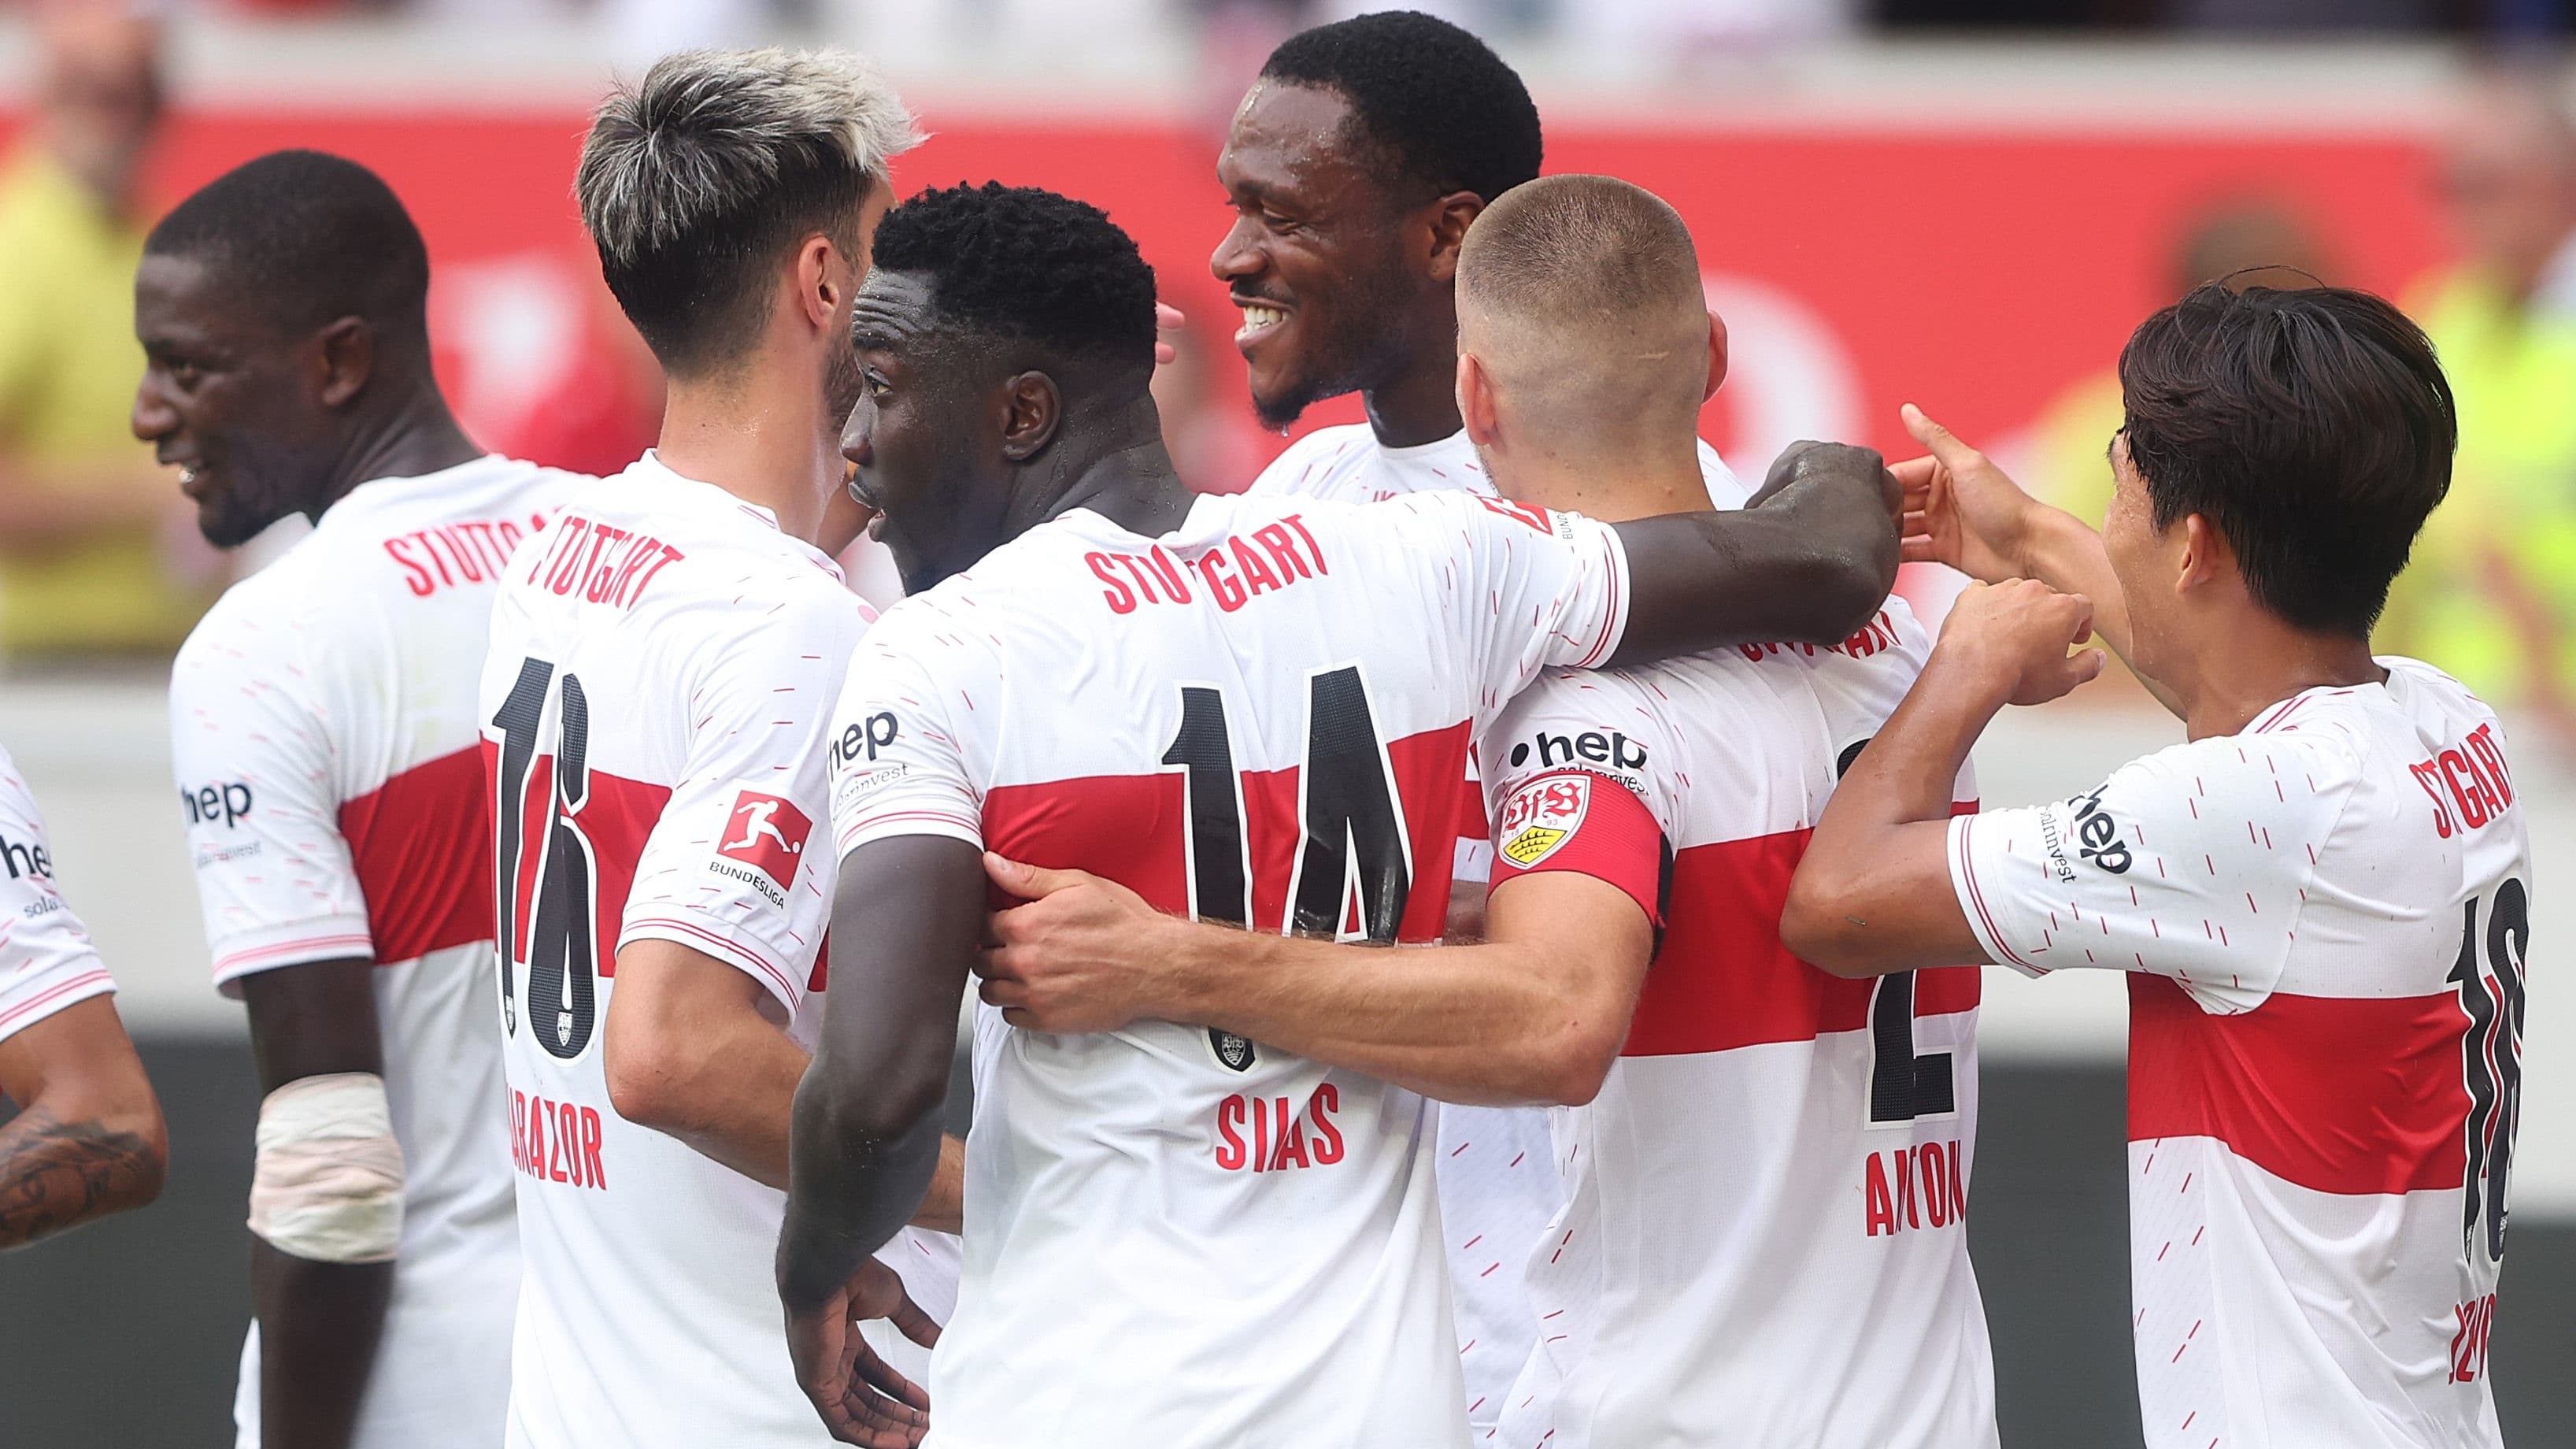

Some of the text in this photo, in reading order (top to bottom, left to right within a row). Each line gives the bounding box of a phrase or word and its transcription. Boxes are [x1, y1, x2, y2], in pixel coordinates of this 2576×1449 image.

[1084, 513, 1328, 614] STUGART
[829, 712, 898, 783] hep
[1536, 732, 1647, 769] hep
[2408, 722, 2515, 839] STGART
[0, 835, 51, 879] he
[709, 862, 785, 910] BUNDESLIGA
[510, 1087, 606, 1191] ARAZOR
